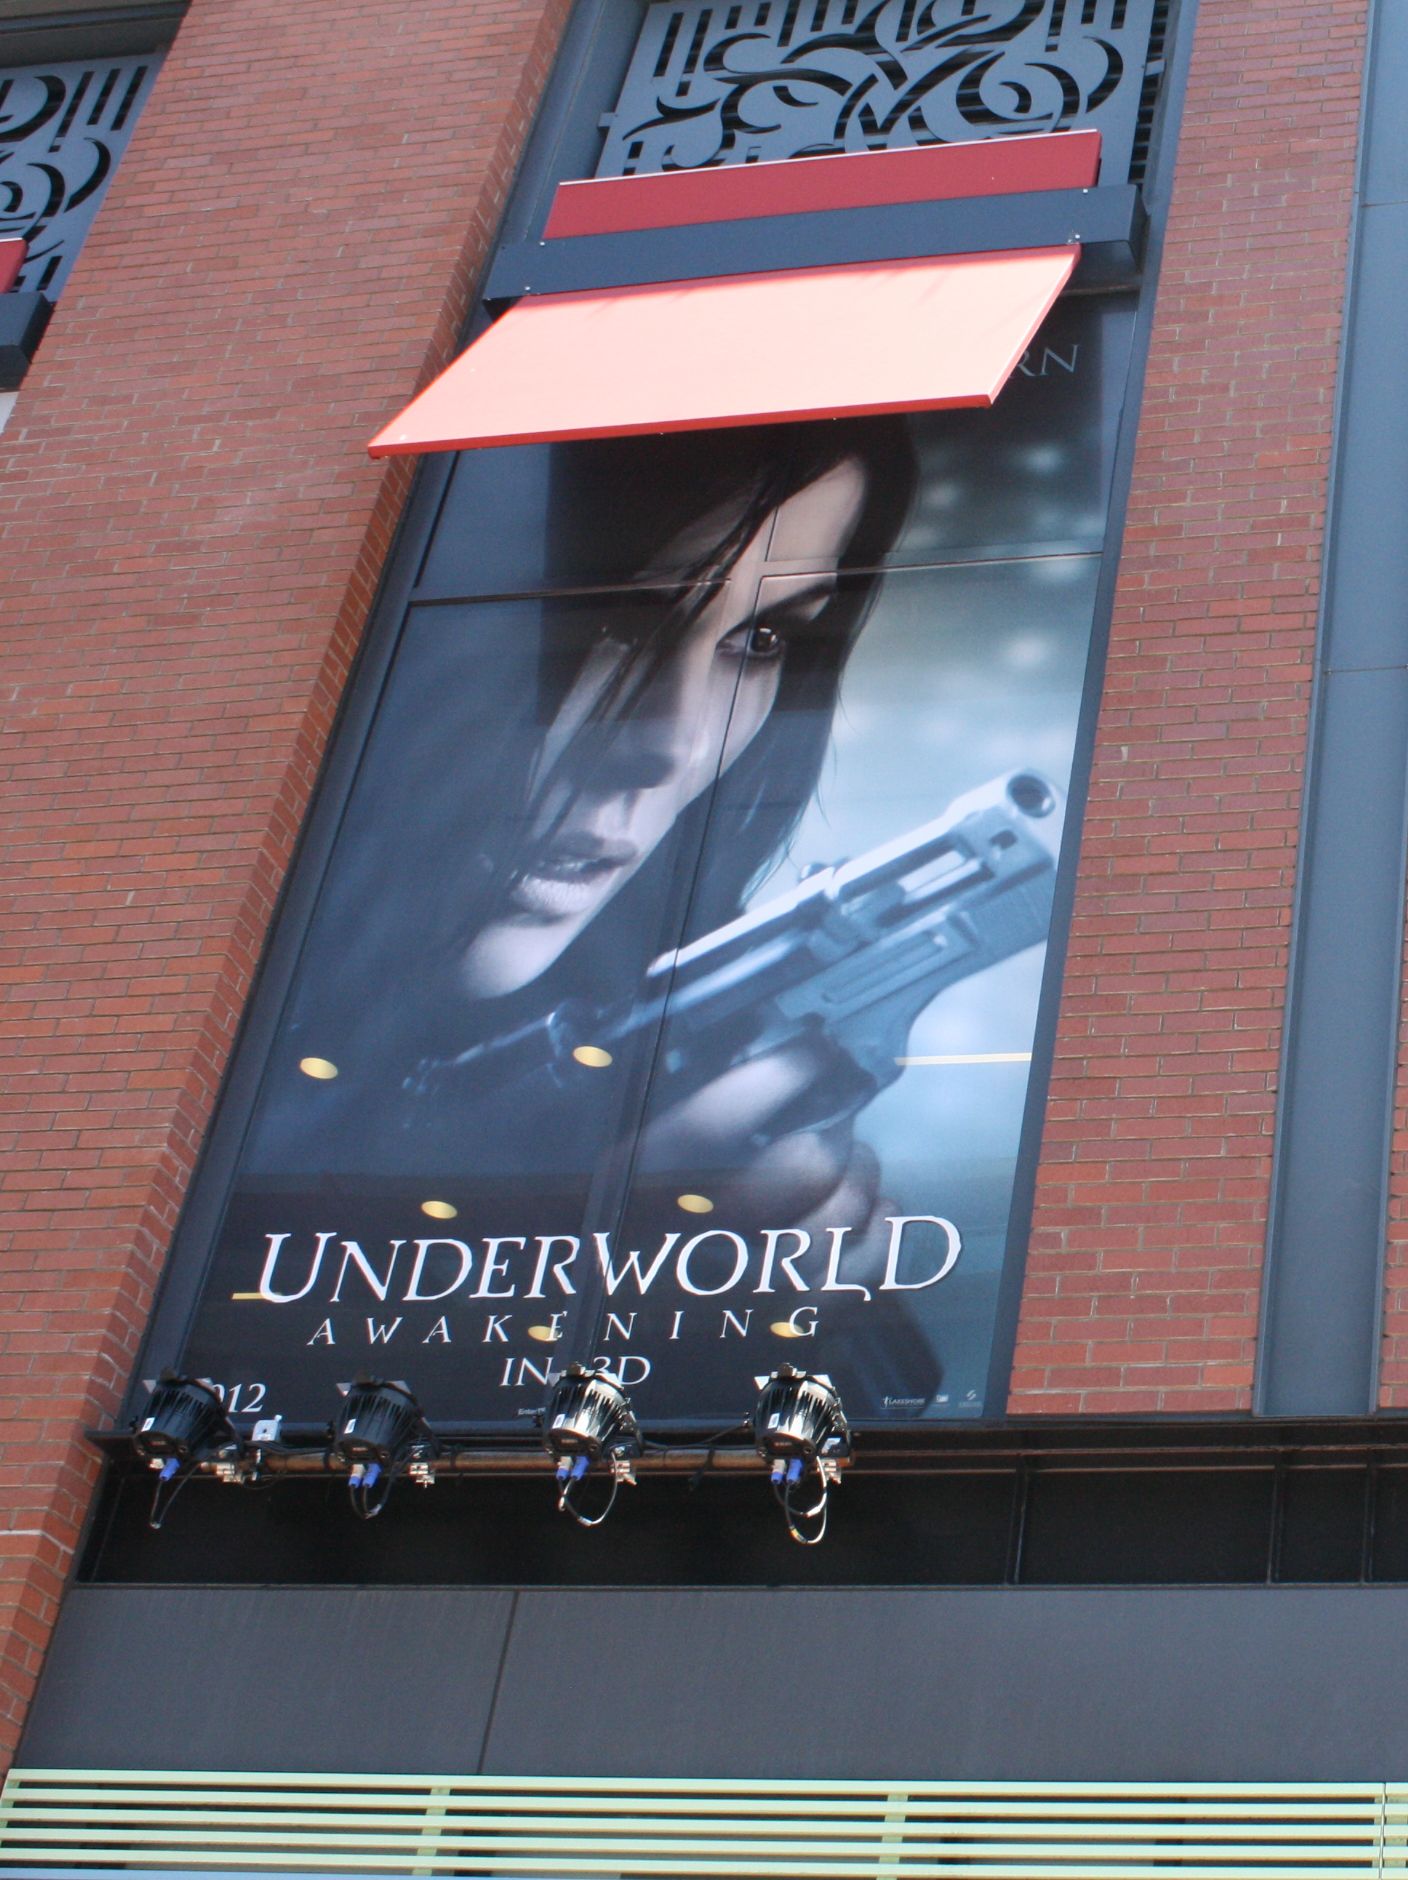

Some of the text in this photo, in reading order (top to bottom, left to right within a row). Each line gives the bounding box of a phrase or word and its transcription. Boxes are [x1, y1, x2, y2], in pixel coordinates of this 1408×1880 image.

[259, 1214, 962, 1304] UNDERWORLD
[307, 1306, 820, 1346] AWAKENING
[498, 1356, 554, 1387] IN
